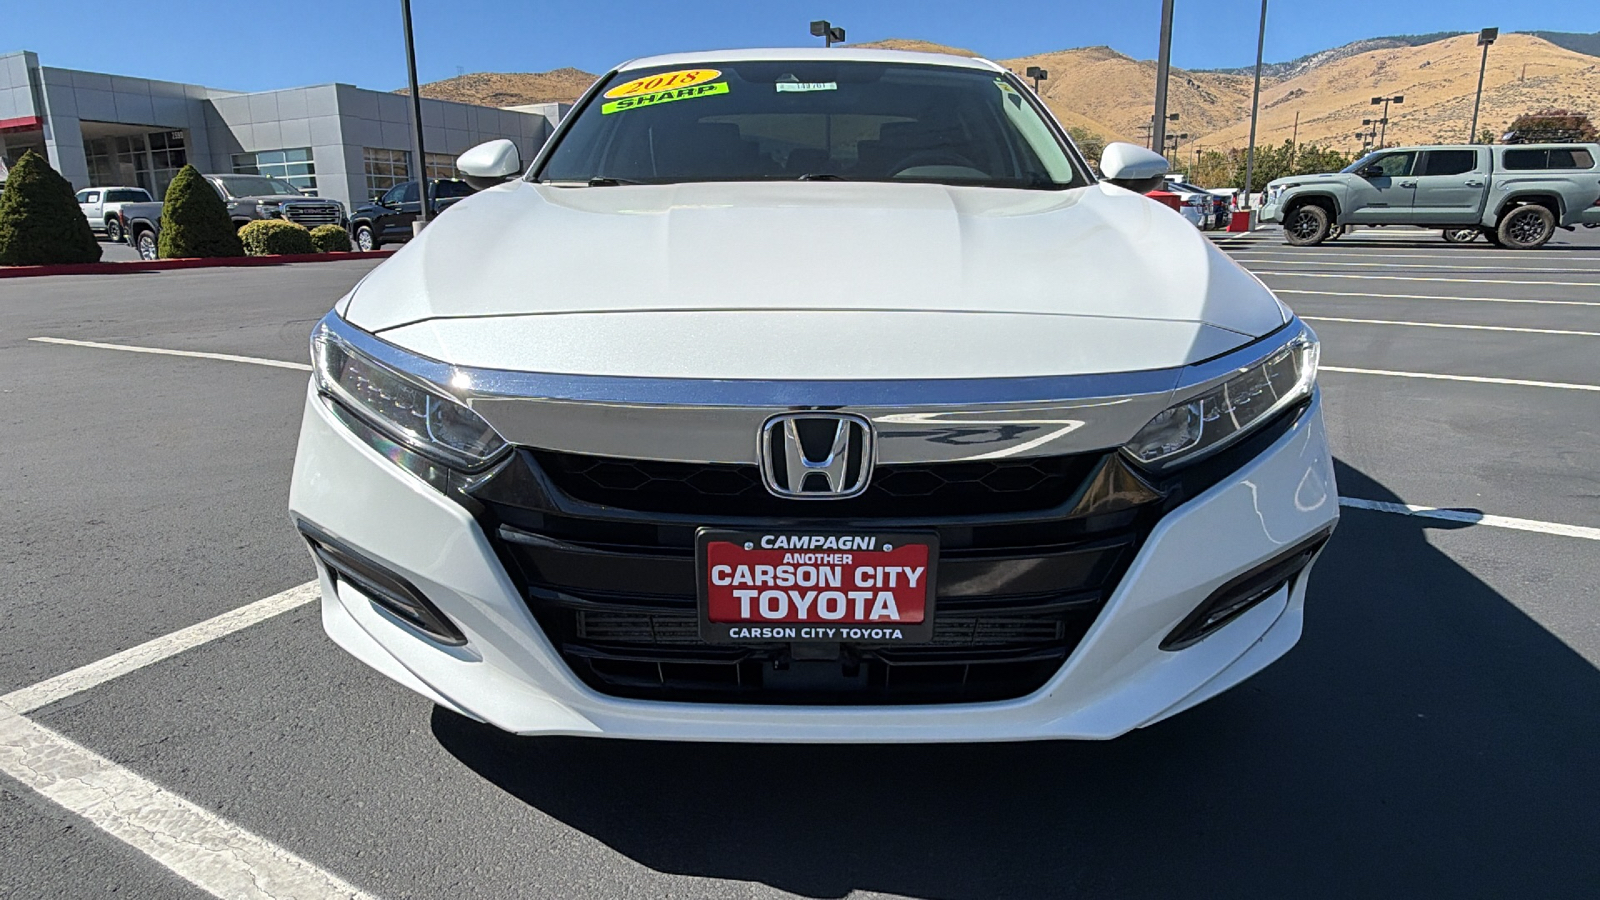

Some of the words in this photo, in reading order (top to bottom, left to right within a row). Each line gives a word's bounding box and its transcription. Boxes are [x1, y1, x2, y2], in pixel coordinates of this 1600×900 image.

[623, 71, 700, 94] 2018
[616, 85, 717, 109] SHARP
[761, 536, 875, 549] CAMPAGNI
[783, 553, 852, 564] ANOTHER
[712, 565, 841, 587] CARSON
[855, 567, 924, 587] CITY
[733, 590, 900, 620] TOYOTA
[730, 628, 795, 637] CARSON
[802, 628, 835, 637] CITY
[840, 629, 902, 638] TOYOTA
